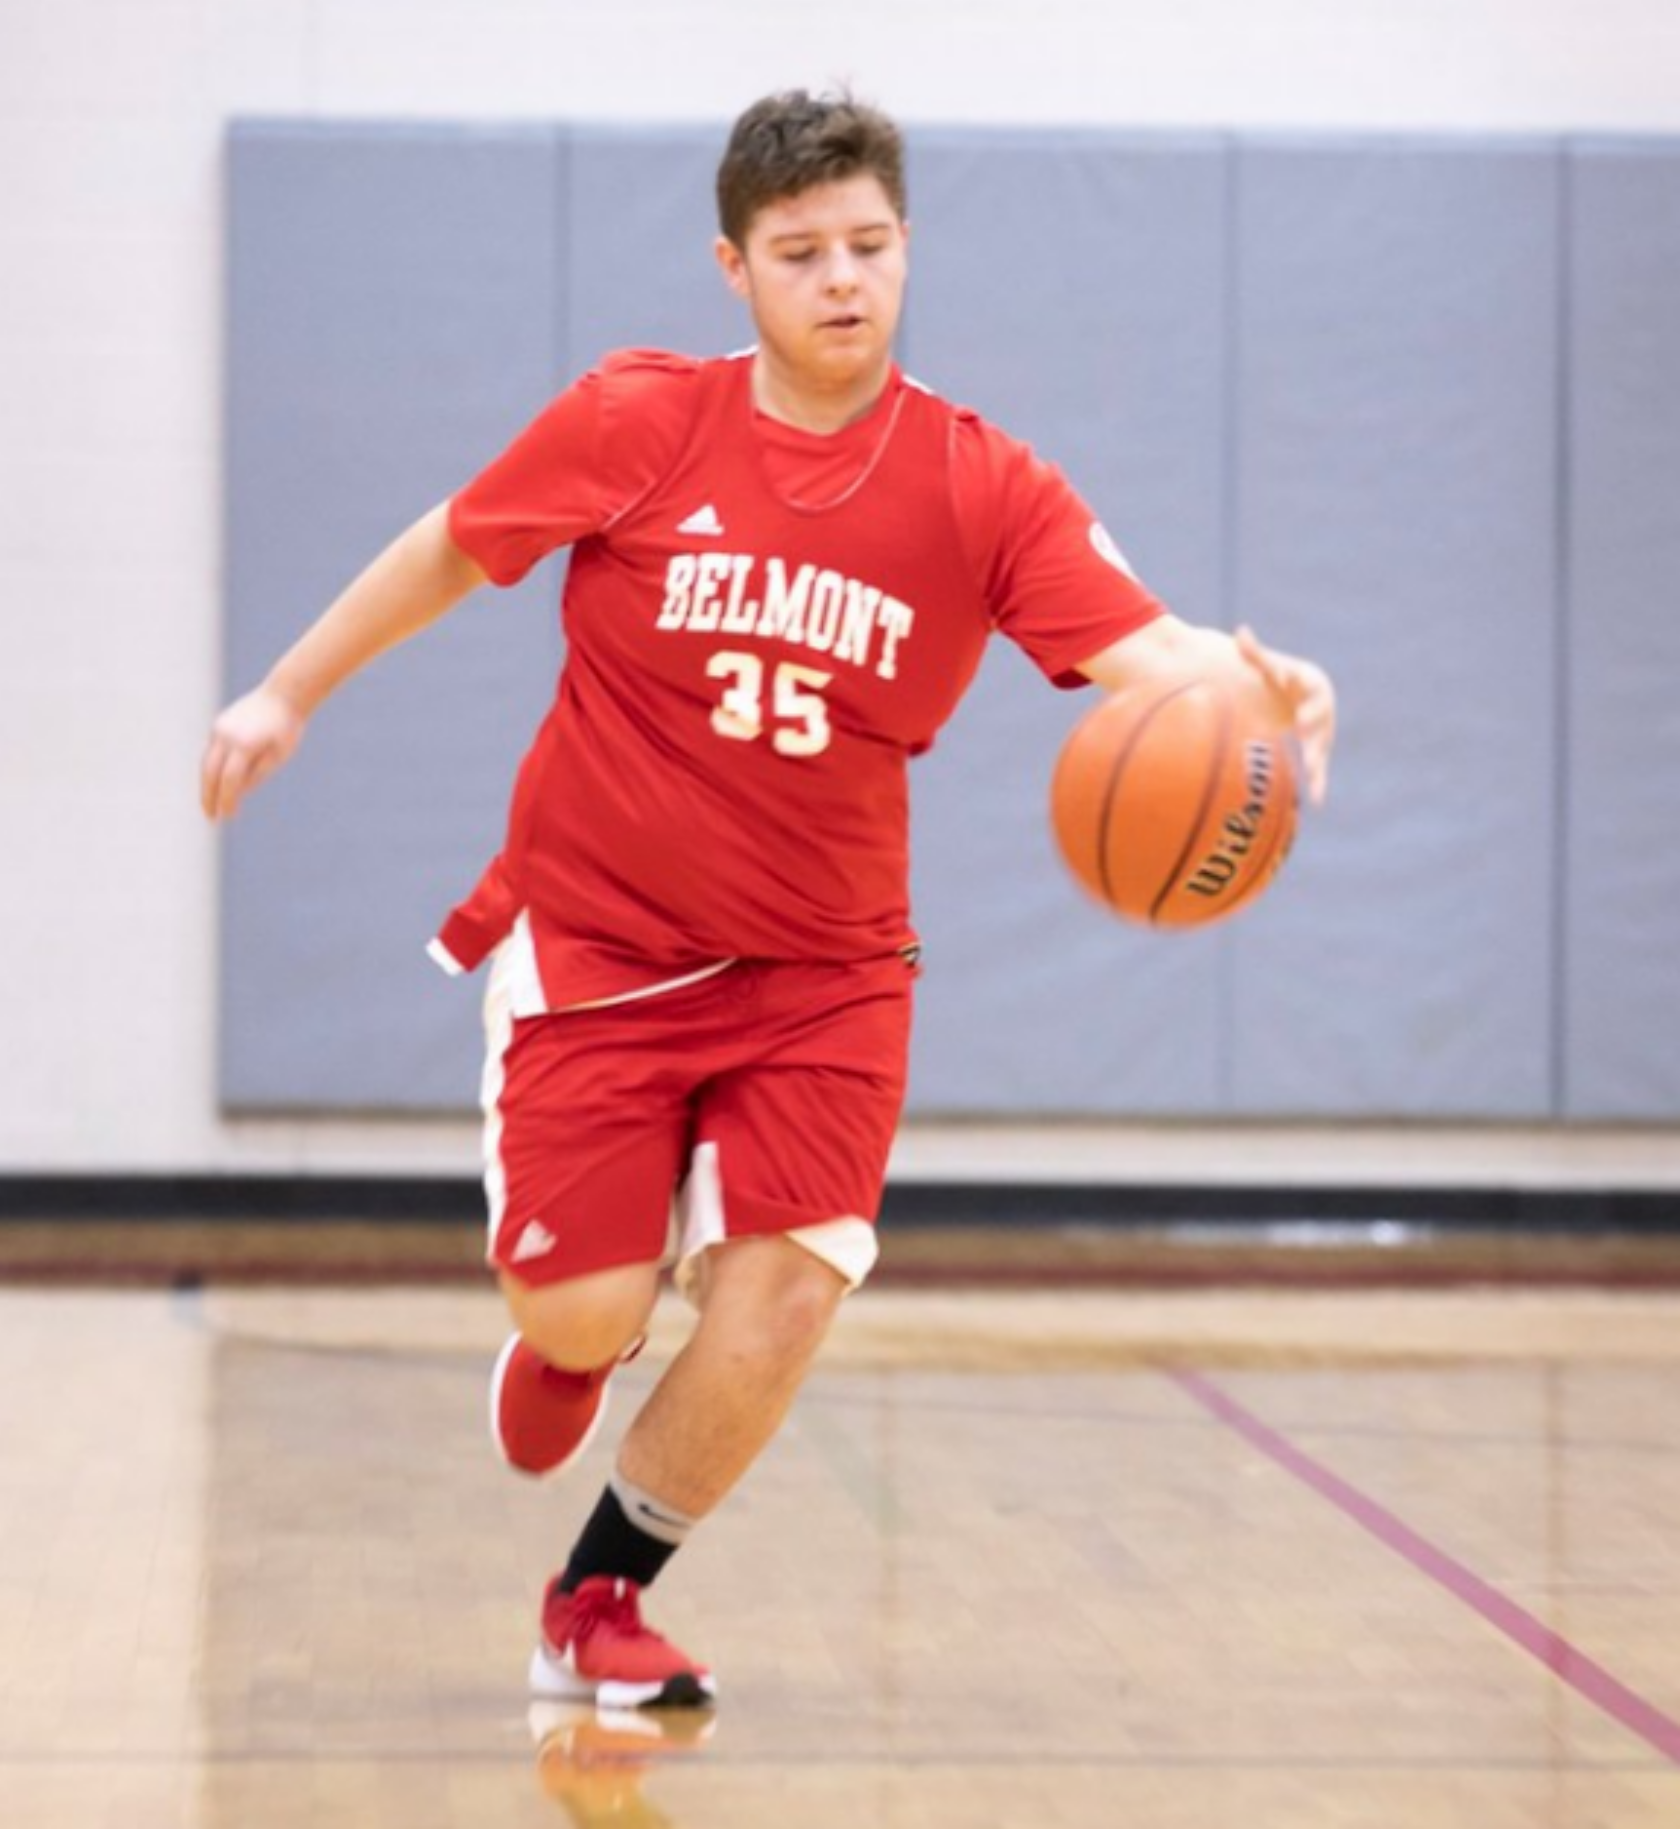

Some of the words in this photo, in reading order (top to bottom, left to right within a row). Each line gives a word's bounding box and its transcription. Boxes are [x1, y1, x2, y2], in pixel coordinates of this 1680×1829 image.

[655, 552, 914, 680] BELMONT
[705, 650, 834, 757] 35
[1186, 741, 1271, 897] Wilson
